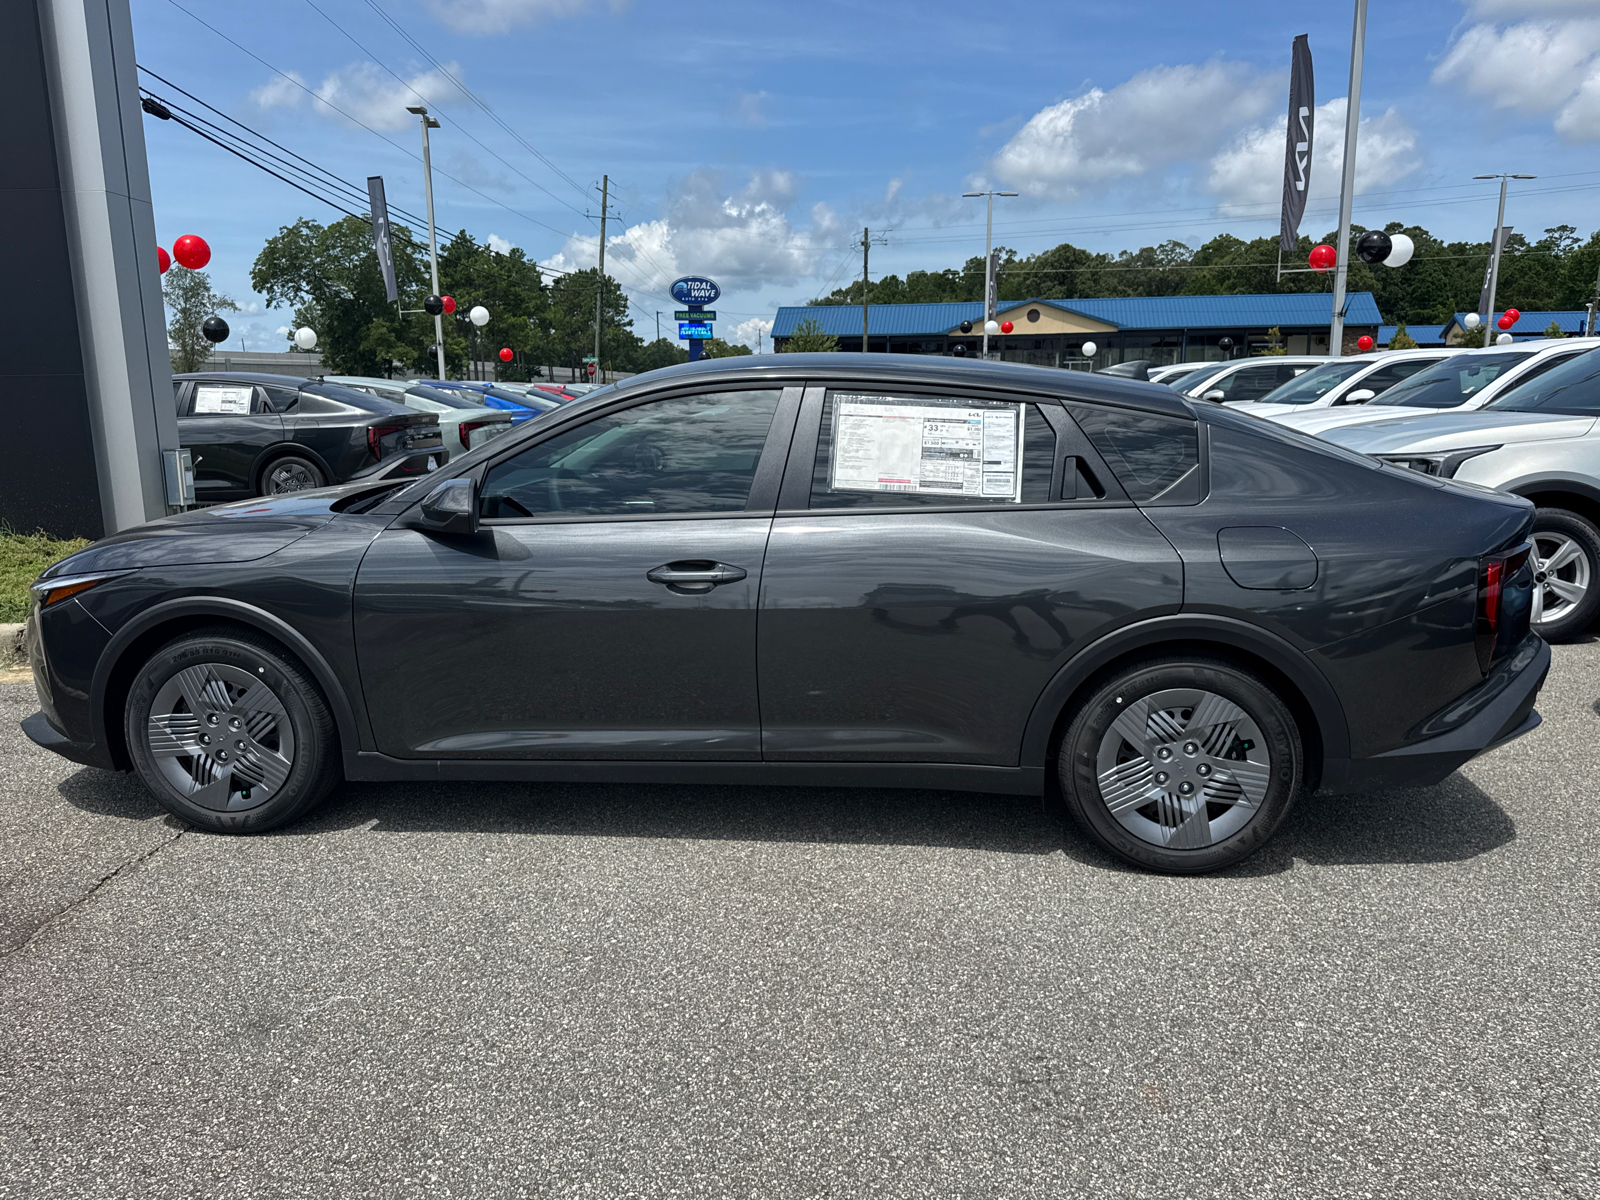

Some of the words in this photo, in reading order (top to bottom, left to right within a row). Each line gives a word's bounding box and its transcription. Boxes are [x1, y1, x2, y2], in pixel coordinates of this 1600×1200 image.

[928, 424, 939, 432] 33
[171, 648, 200, 662] 205/55
[222, 649, 241, 659] 91H
[1270, 715, 1290, 781] KUMHO
[288, 740, 311, 797] KUMHO
